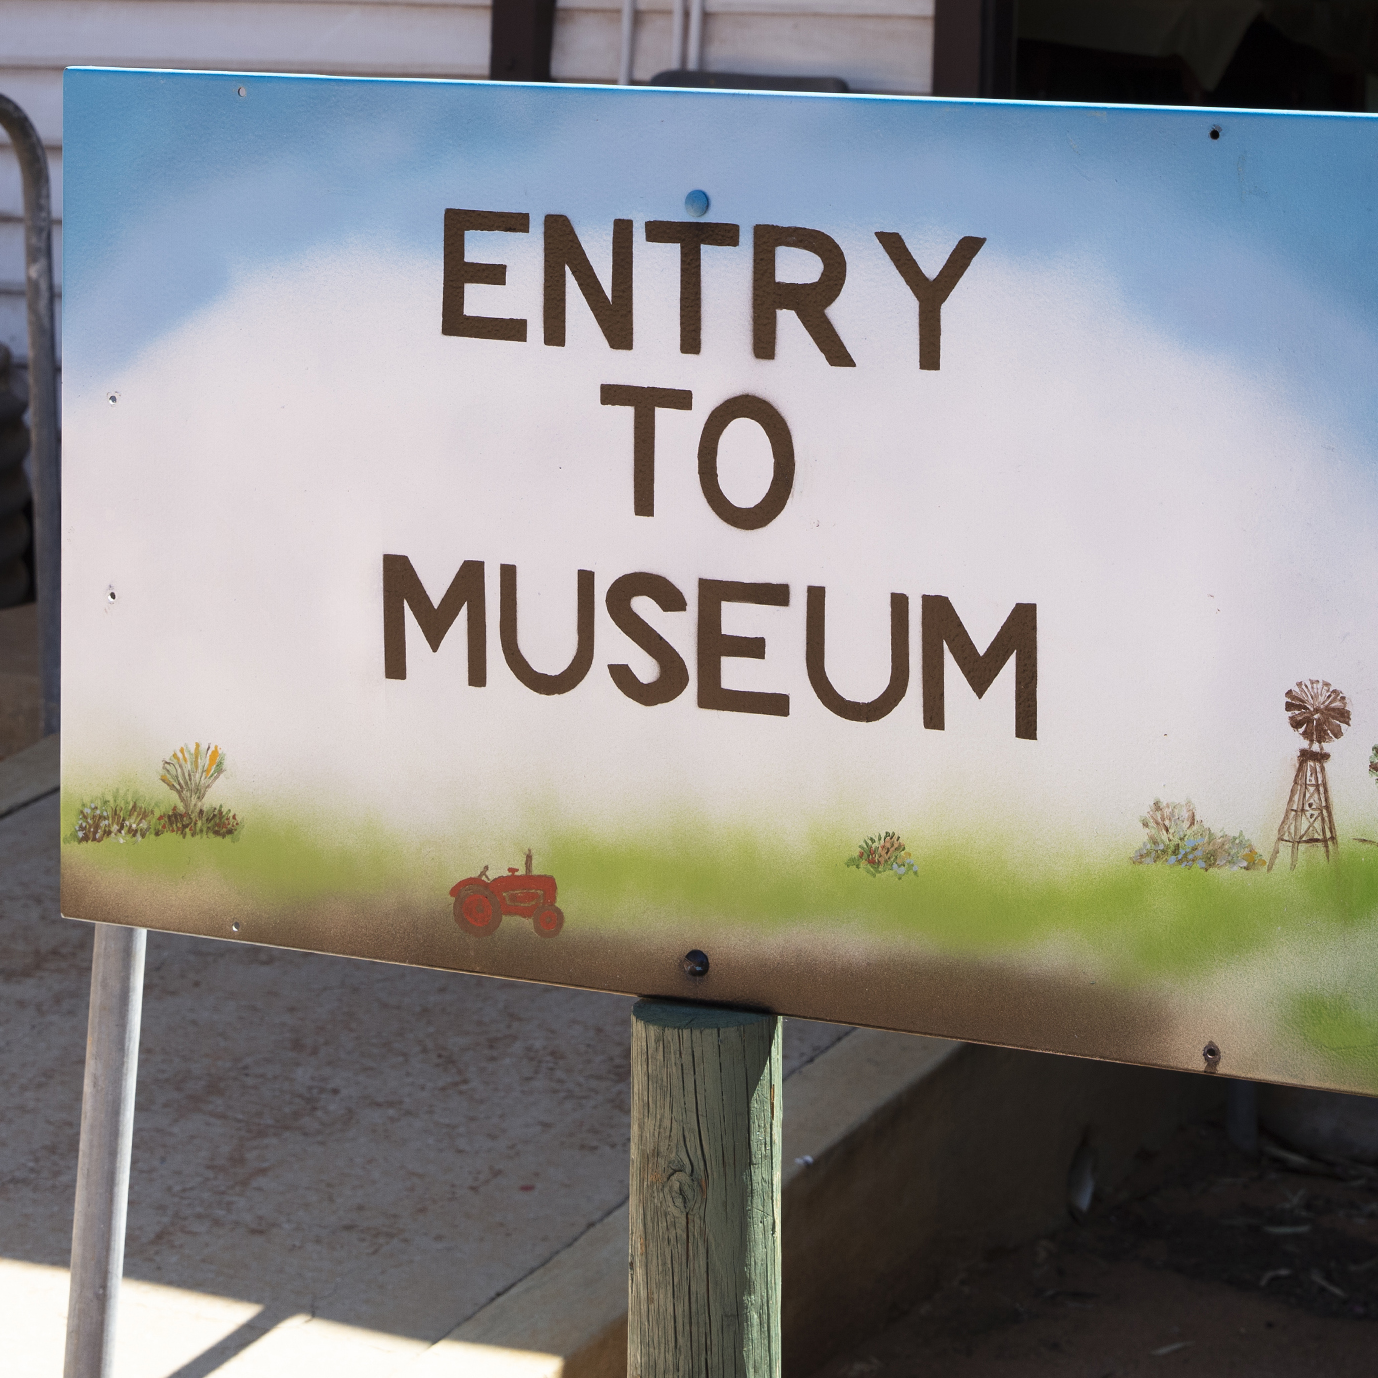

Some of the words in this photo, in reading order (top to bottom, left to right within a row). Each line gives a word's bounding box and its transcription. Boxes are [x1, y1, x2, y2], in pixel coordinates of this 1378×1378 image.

[441, 208, 987, 371] ENTRY
[600, 383, 795, 531] TO
[382, 553, 1038, 741] MUSEUM
